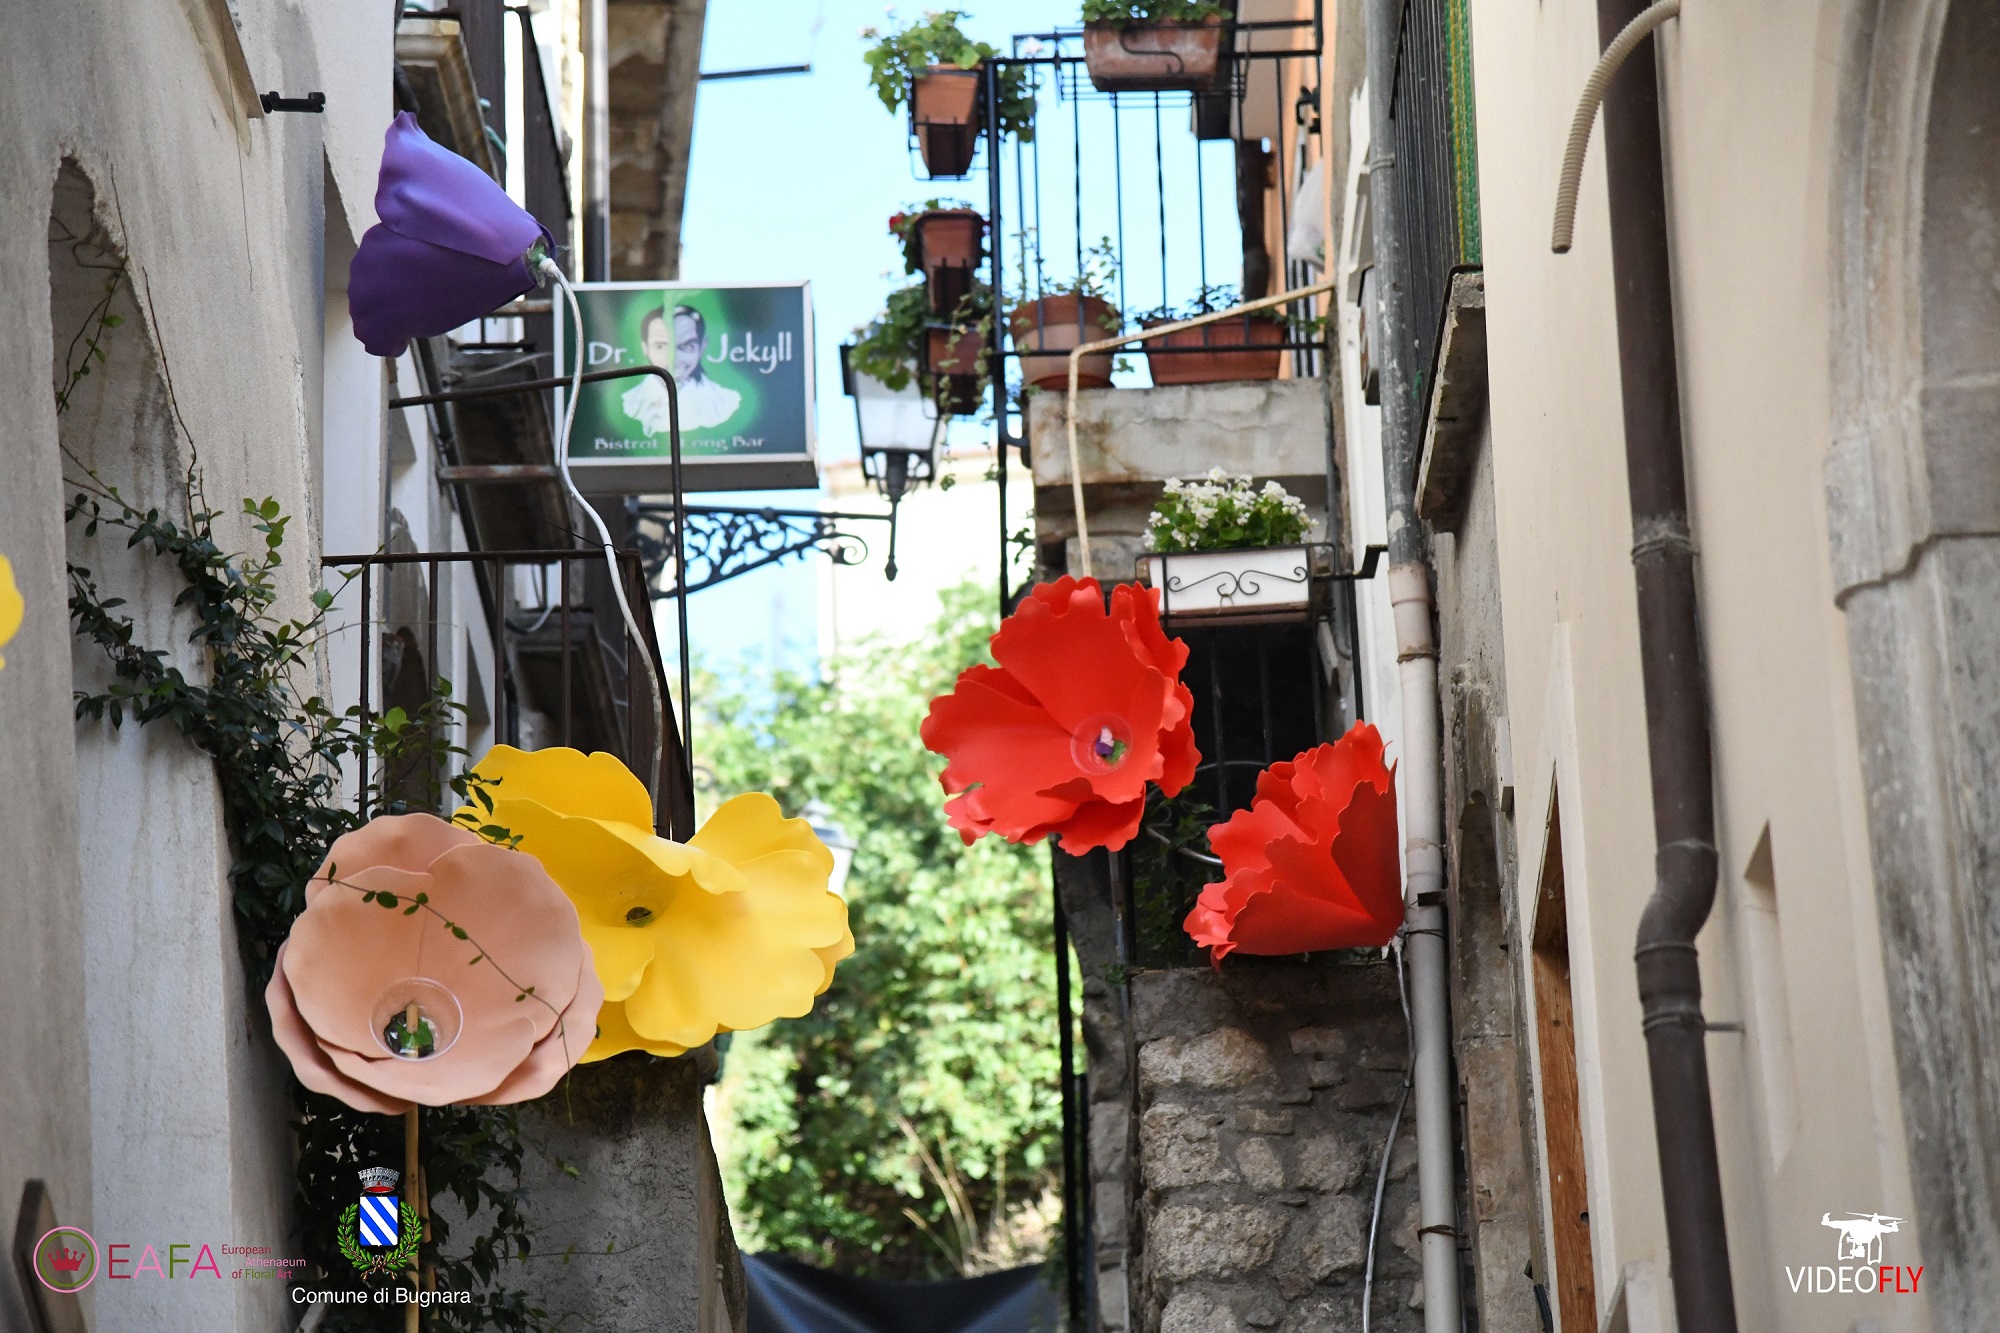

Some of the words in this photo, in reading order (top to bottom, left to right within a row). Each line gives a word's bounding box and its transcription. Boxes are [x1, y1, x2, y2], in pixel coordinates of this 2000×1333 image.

[588, 341, 634, 366] Dr.
[706, 331, 792, 374] Jekyll
[732, 435, 766, 448] Bar
